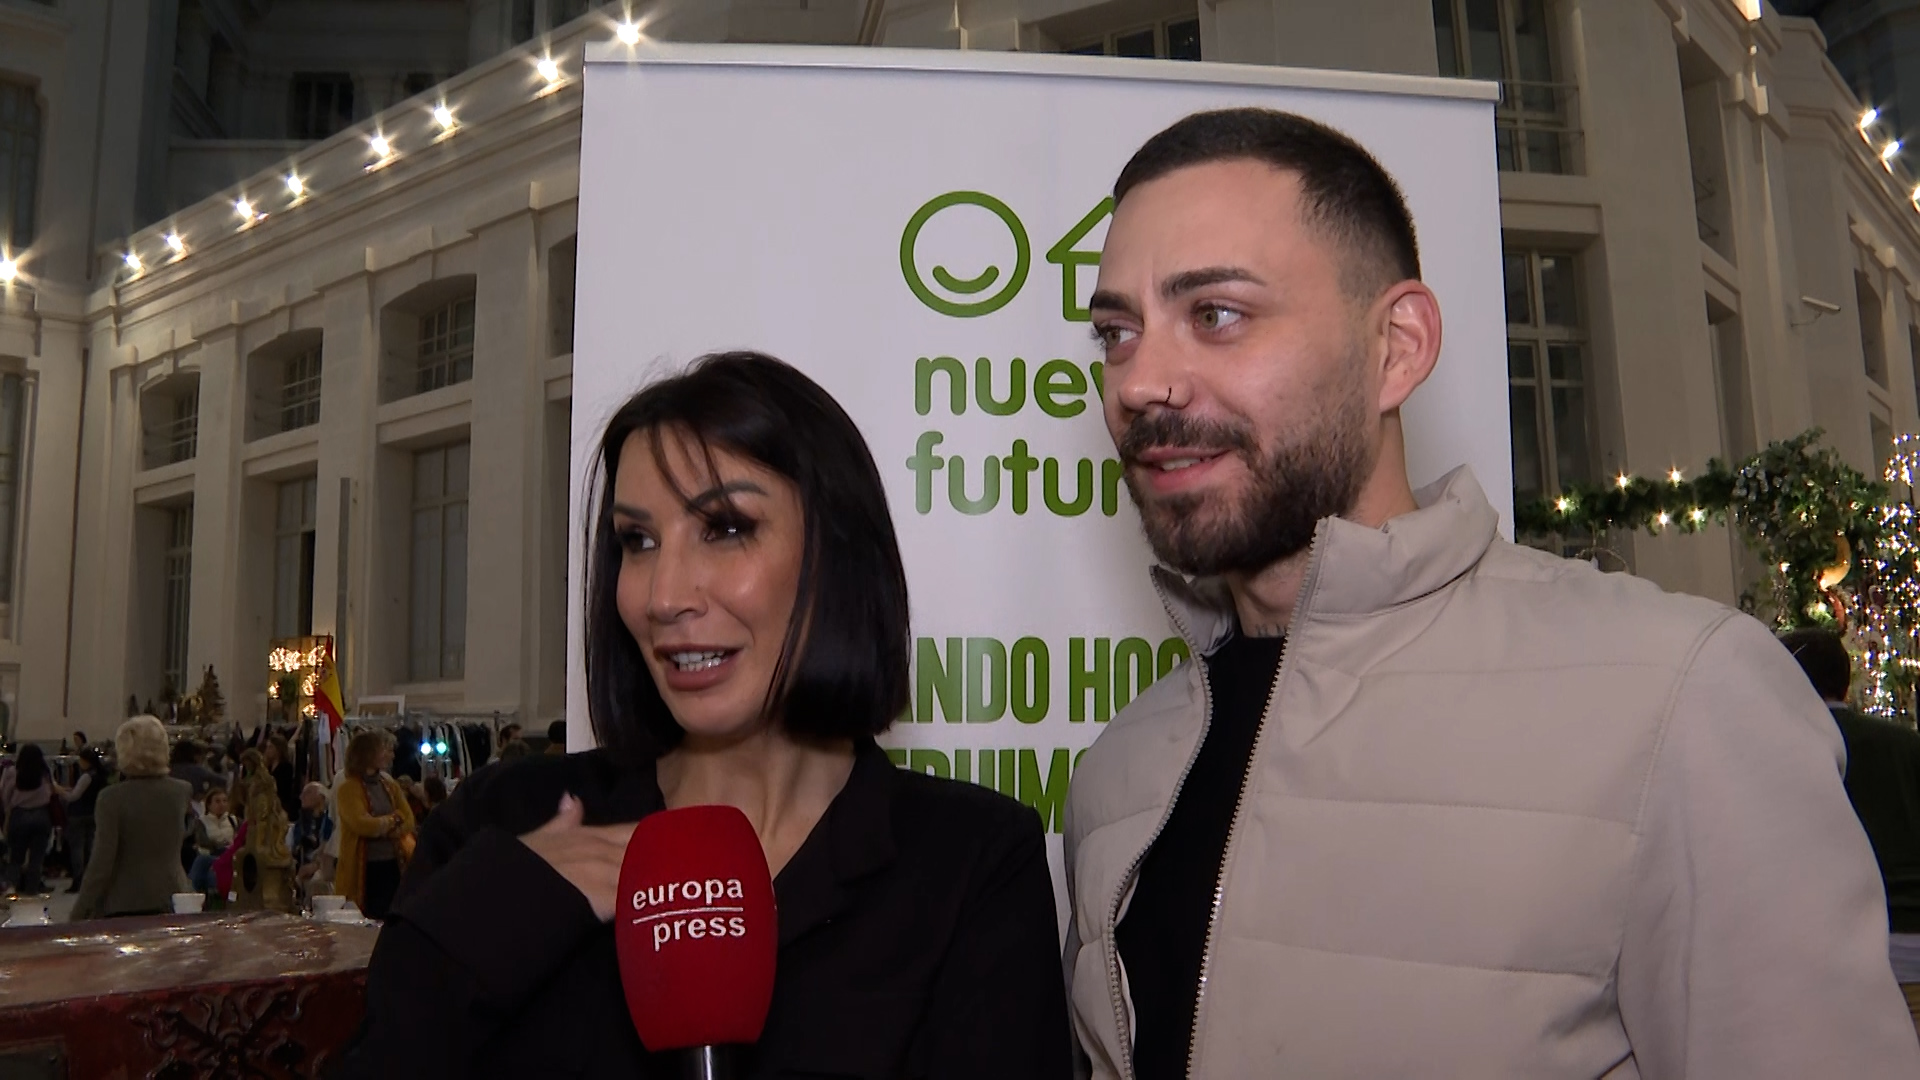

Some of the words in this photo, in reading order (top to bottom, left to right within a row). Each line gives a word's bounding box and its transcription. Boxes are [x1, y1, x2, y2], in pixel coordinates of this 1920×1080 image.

[896, 636, 1050, 724] NDO
[632, 878, 744, 911] europa
[653, 916, 746, 952] press
